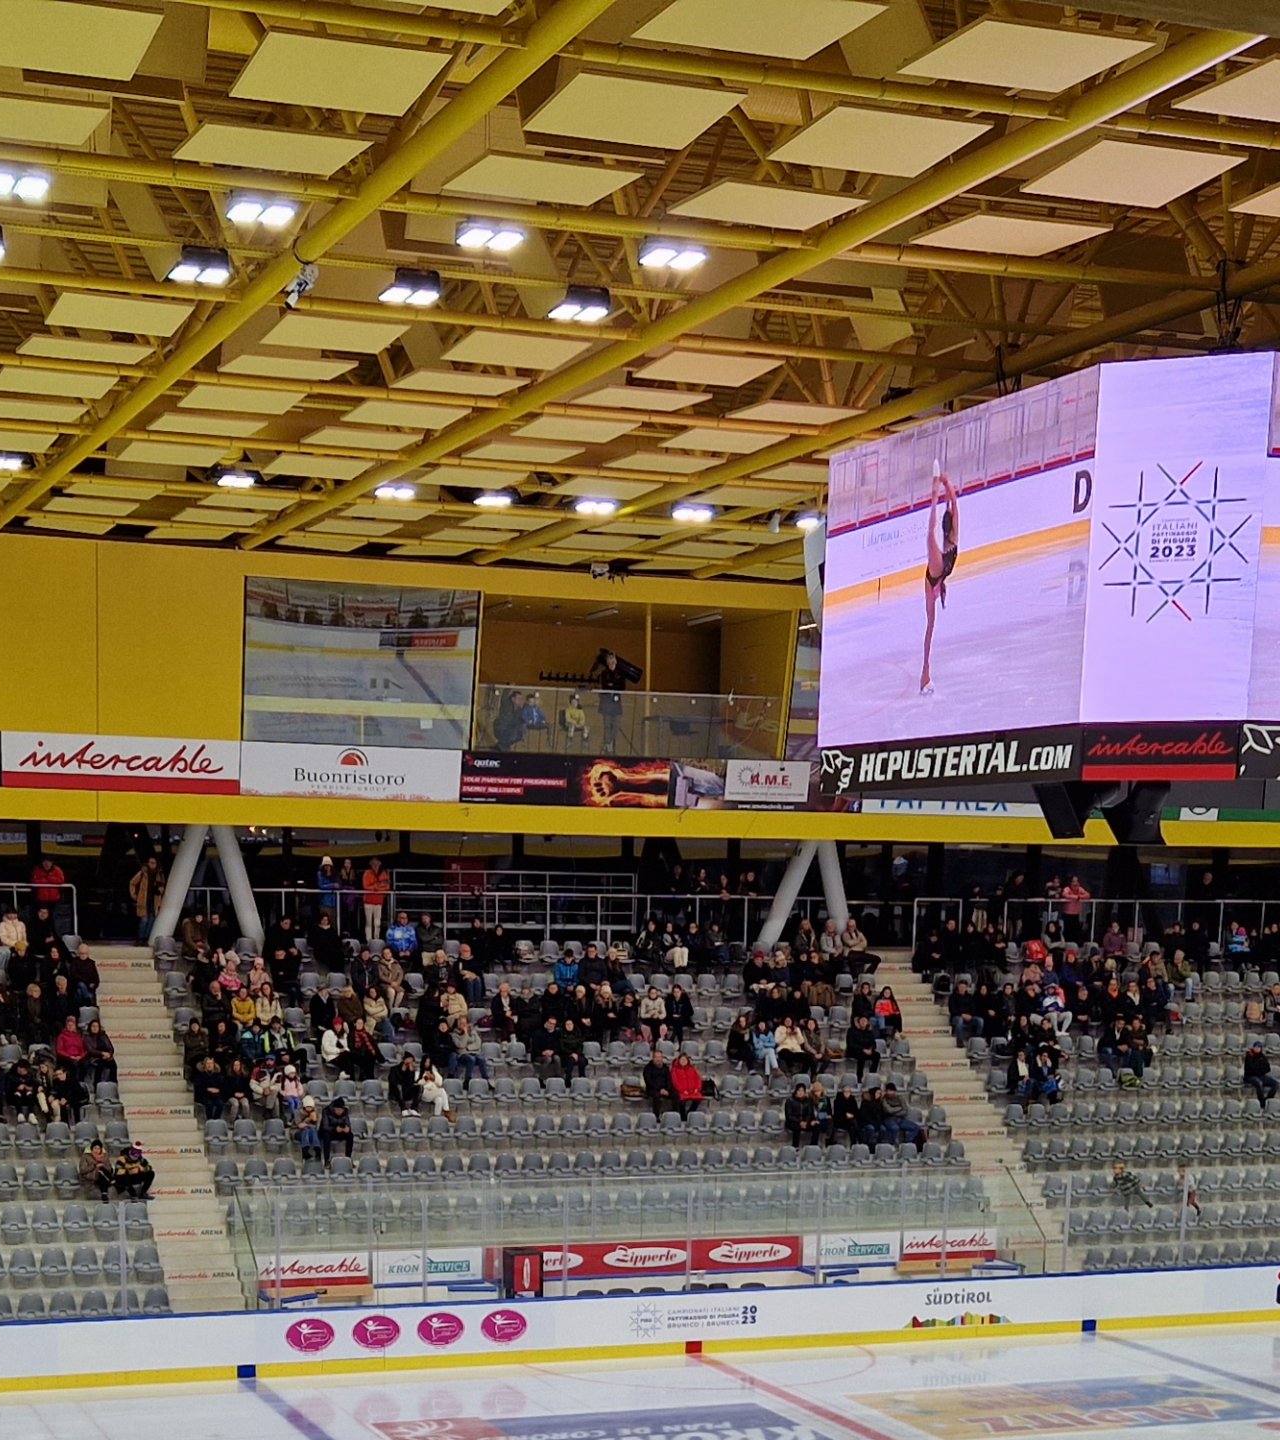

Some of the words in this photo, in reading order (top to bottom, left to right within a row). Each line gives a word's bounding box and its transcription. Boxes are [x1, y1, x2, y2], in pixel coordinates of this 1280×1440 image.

[1073, 470, 1092, 514] D
[1152, 522, 1198, 531] ITALIANI
[1164, 536, 1197, 544] FIGURA
[1150, 545, 1196, 559] 2023
[1087, 731, 1236, 758] intercable
[19, 740, 223, 775] intercable
[859, 743, 1073, 782] HCPUSTERTAL.COM
[293, 767, 405, 788] Buonristoro
[849, 1243, 890, 1255] SERVICE
[905, 1233, 992, 1251] intercable
[616, 1245, 677, 1266] Zipperle
[720, 1240, 781, 1263] Zipperle
[260, 1256, 366, 1280] intercable
[388, 1264, 421, 1275] KRON
[427, 1260, 470, 1273] SERVICE
[667, 1307, 708, 1315] CAMPIONATI
[741, 1305, 758, 1315] 20
[741, 1315, 757, 1324] 23
[617, 1426, 651, 1436] DE
[663, 1420, 731, 1433] PLAN
